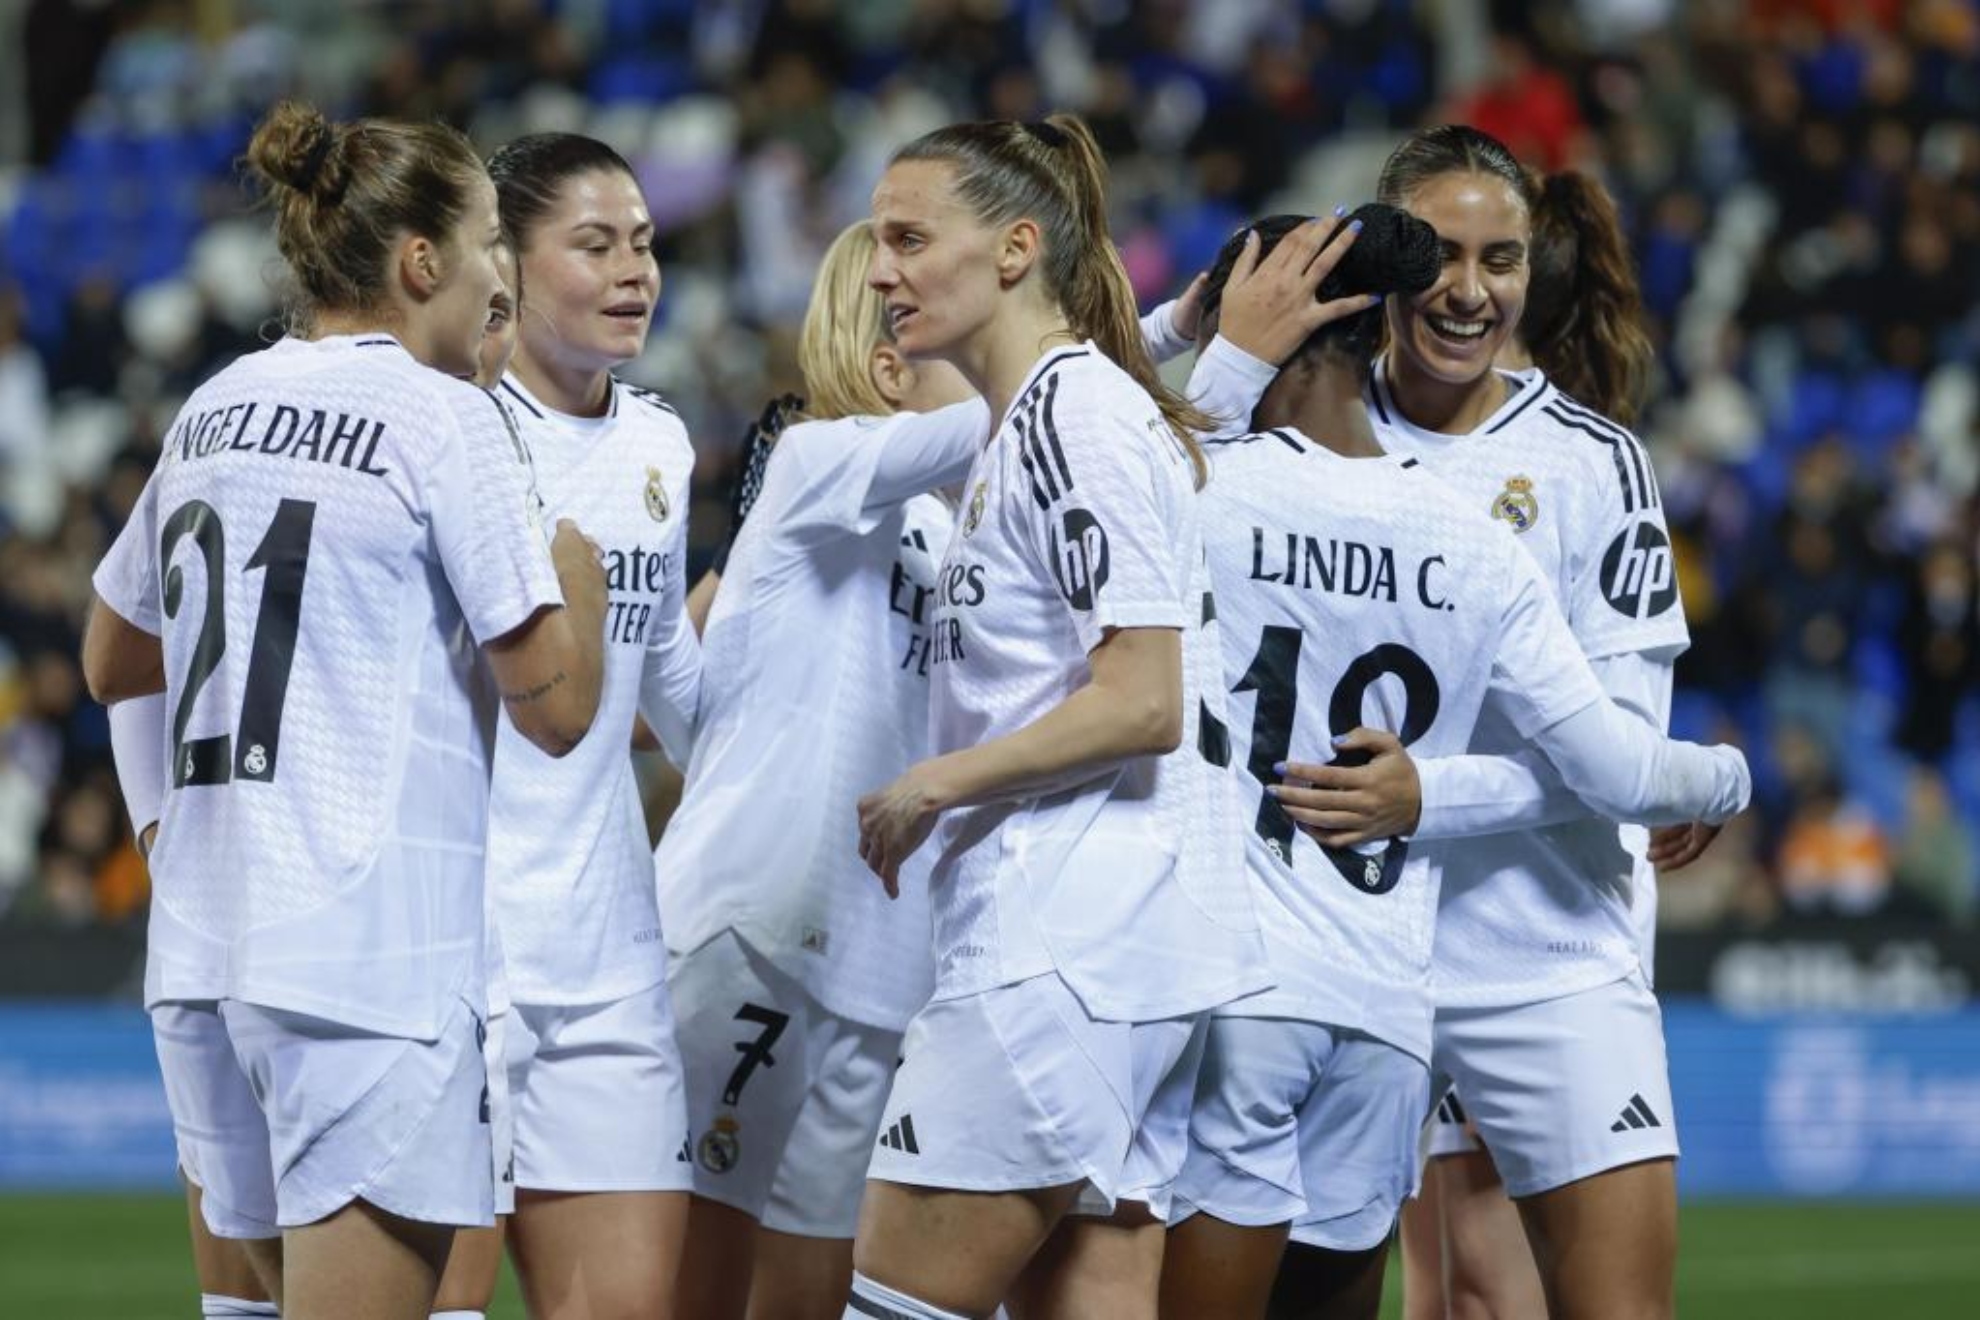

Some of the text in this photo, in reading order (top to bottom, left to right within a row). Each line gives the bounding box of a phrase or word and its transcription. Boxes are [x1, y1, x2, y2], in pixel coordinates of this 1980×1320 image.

[170, 401, 390, 477] NGELDAHL
[1053, 508, 1107, 612] hp
[1249, 526, 1455, 610] LINDA C.
[1605, 520, 1674, 619] hp
[161, 498, 317, 790] 21
[722, 1002, 790, 1108] 7
